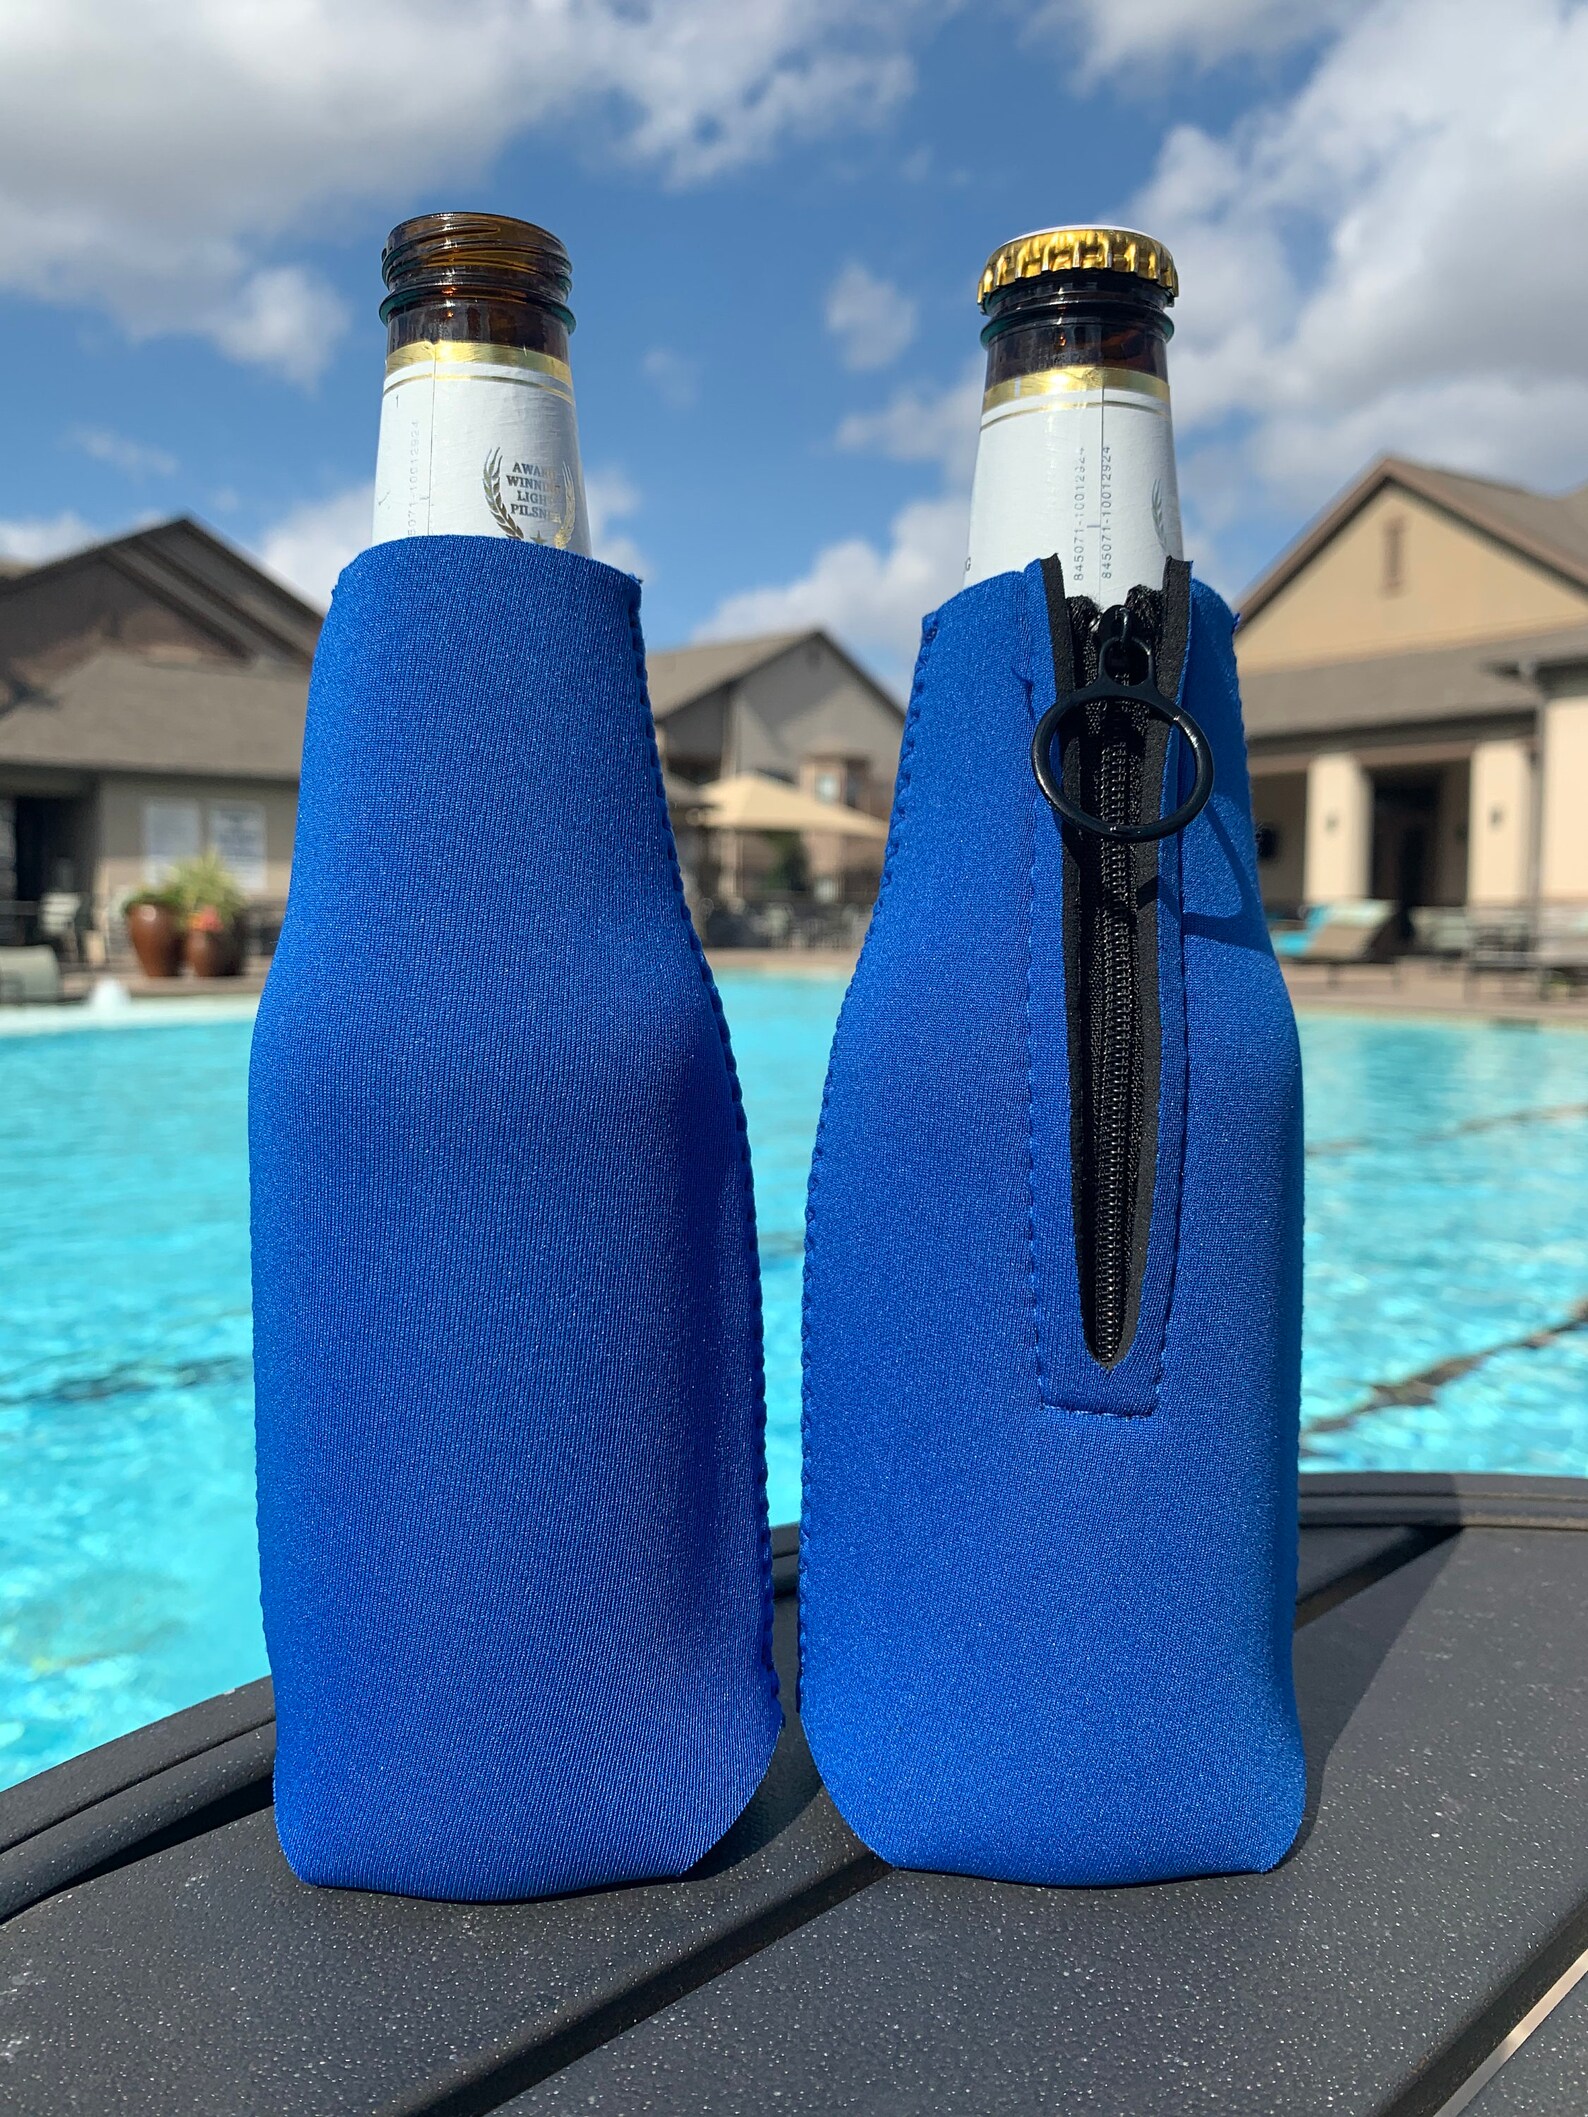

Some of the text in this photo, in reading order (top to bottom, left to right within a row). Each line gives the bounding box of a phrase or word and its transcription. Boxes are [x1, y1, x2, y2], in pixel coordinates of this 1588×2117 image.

[517, 490, 553, 506] LIGH
[511, 503, 561, 523] PILSN
[1101, 446, 1112, 580] 845071-10012924
